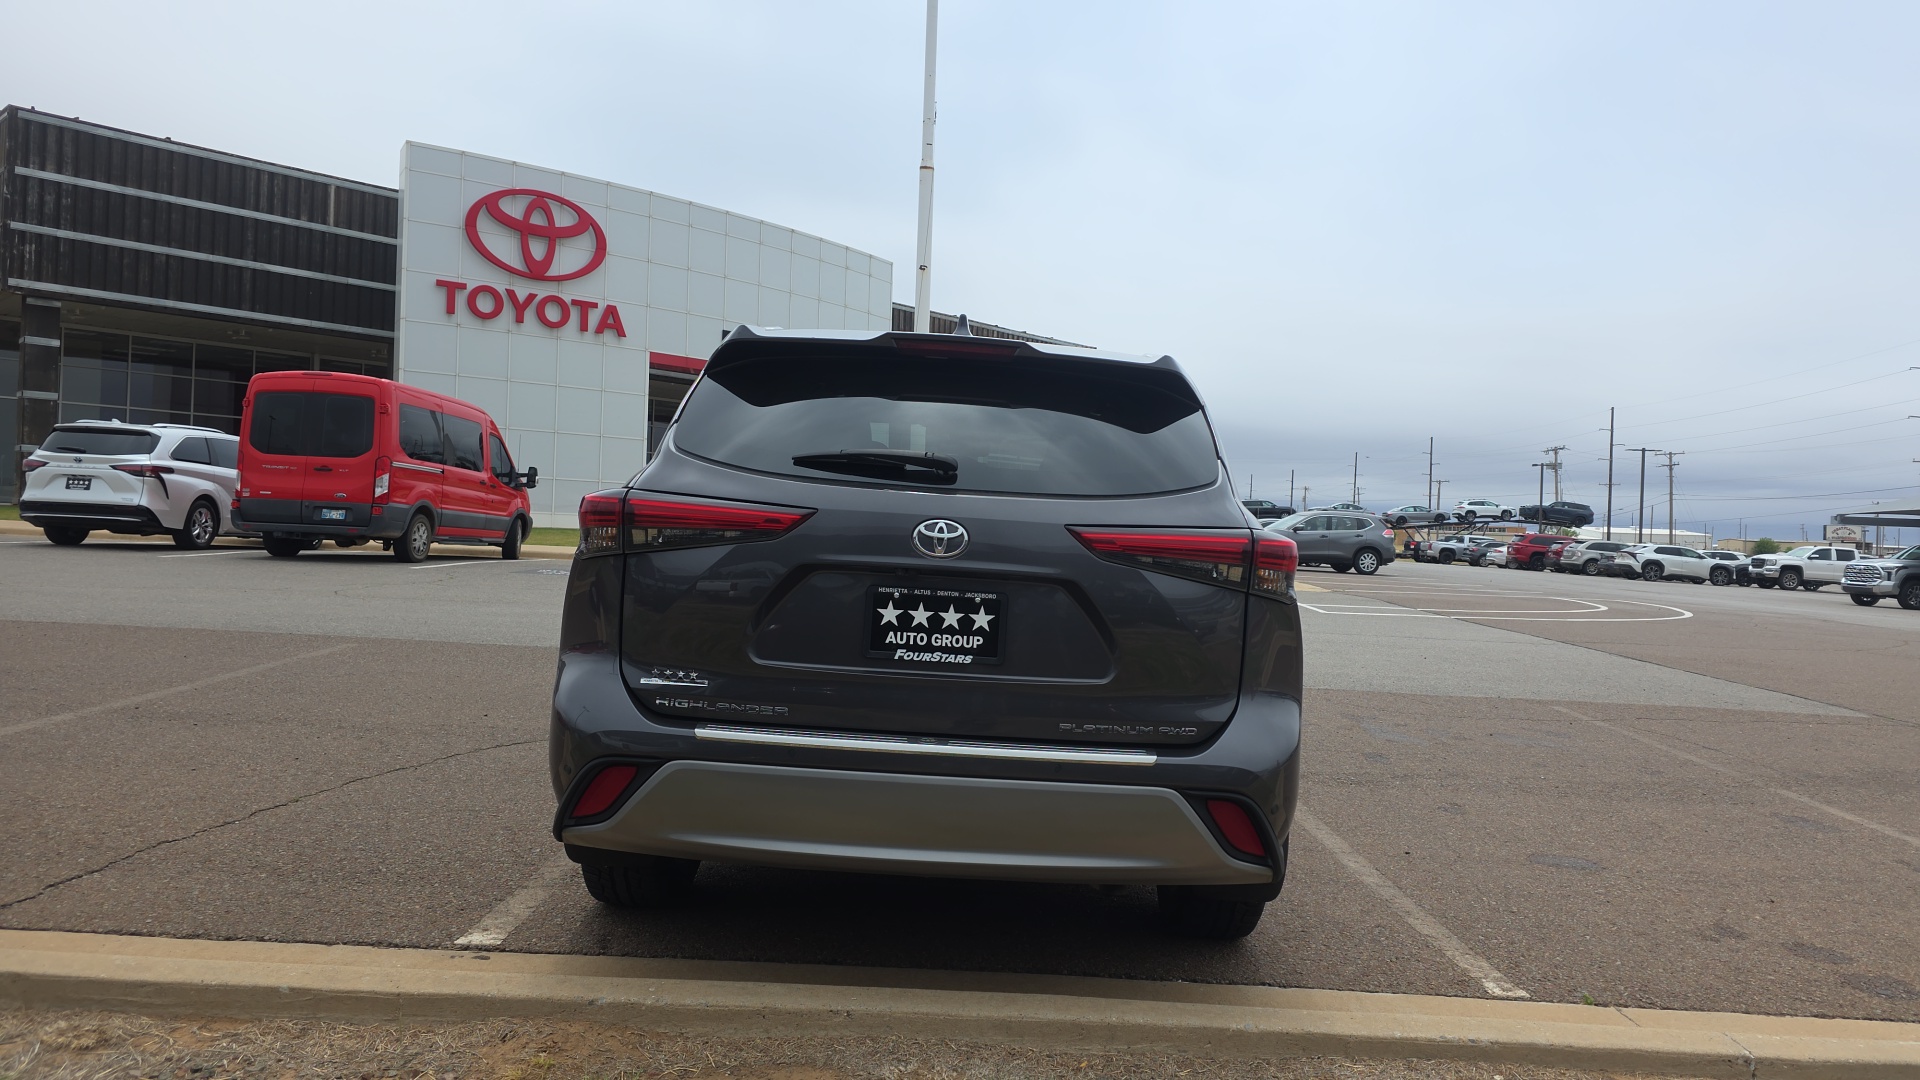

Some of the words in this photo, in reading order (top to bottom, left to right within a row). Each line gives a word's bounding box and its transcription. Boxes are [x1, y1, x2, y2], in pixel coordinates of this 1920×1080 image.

[435, 279, 627, 338] TOYOTA
[885, 631, 927, 646] AUTO
[931, 634, 983, 648] GROUP
[655, 696, 789, 716] HIGHLANDER
[1058, 723, 1154, 735] PLATINUM
[1158, 727, 1198, 736] AWD
